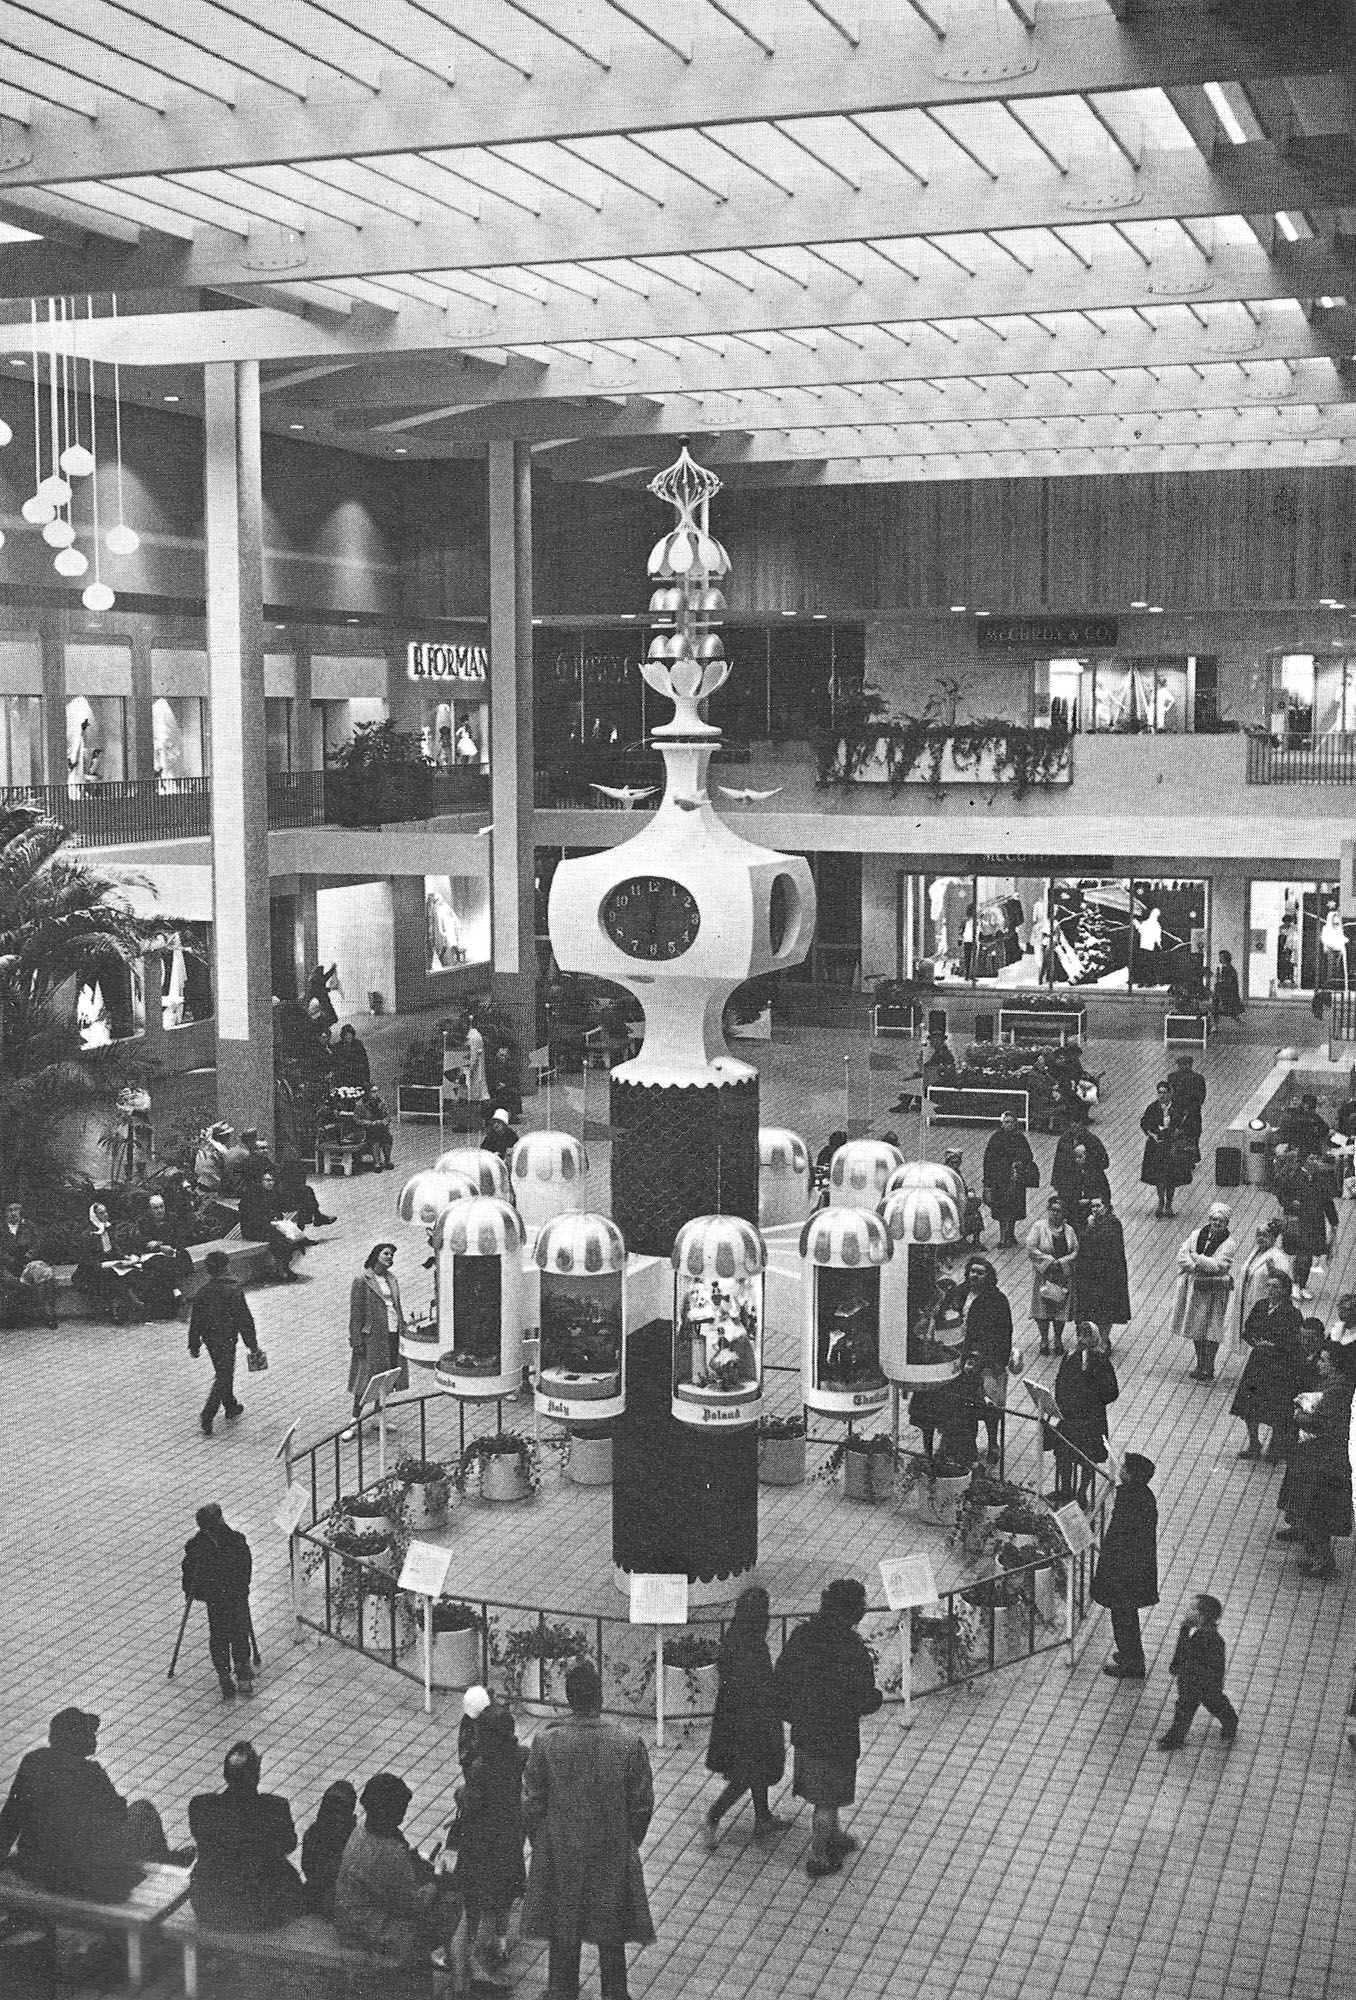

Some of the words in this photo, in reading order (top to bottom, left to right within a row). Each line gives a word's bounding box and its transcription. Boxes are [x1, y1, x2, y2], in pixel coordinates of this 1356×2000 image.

[631, 884, 641, 896] 11
[648, 880, 660, 892] 12
[671, 885, 677, 897] 1
[615, 895, 628, 907] 10
[683, 895, 692, 908] 2
[609, 910, 616, 922] 9
[682, 930, 690, 943] 4
[630, 939, 639, 951] 7
[649, 943, 658, 956] 6
[667, 941, 676, 954] 5
[547, 1399, 570, 1416] Italy
[702, 1407, 741, 1422] Poland
